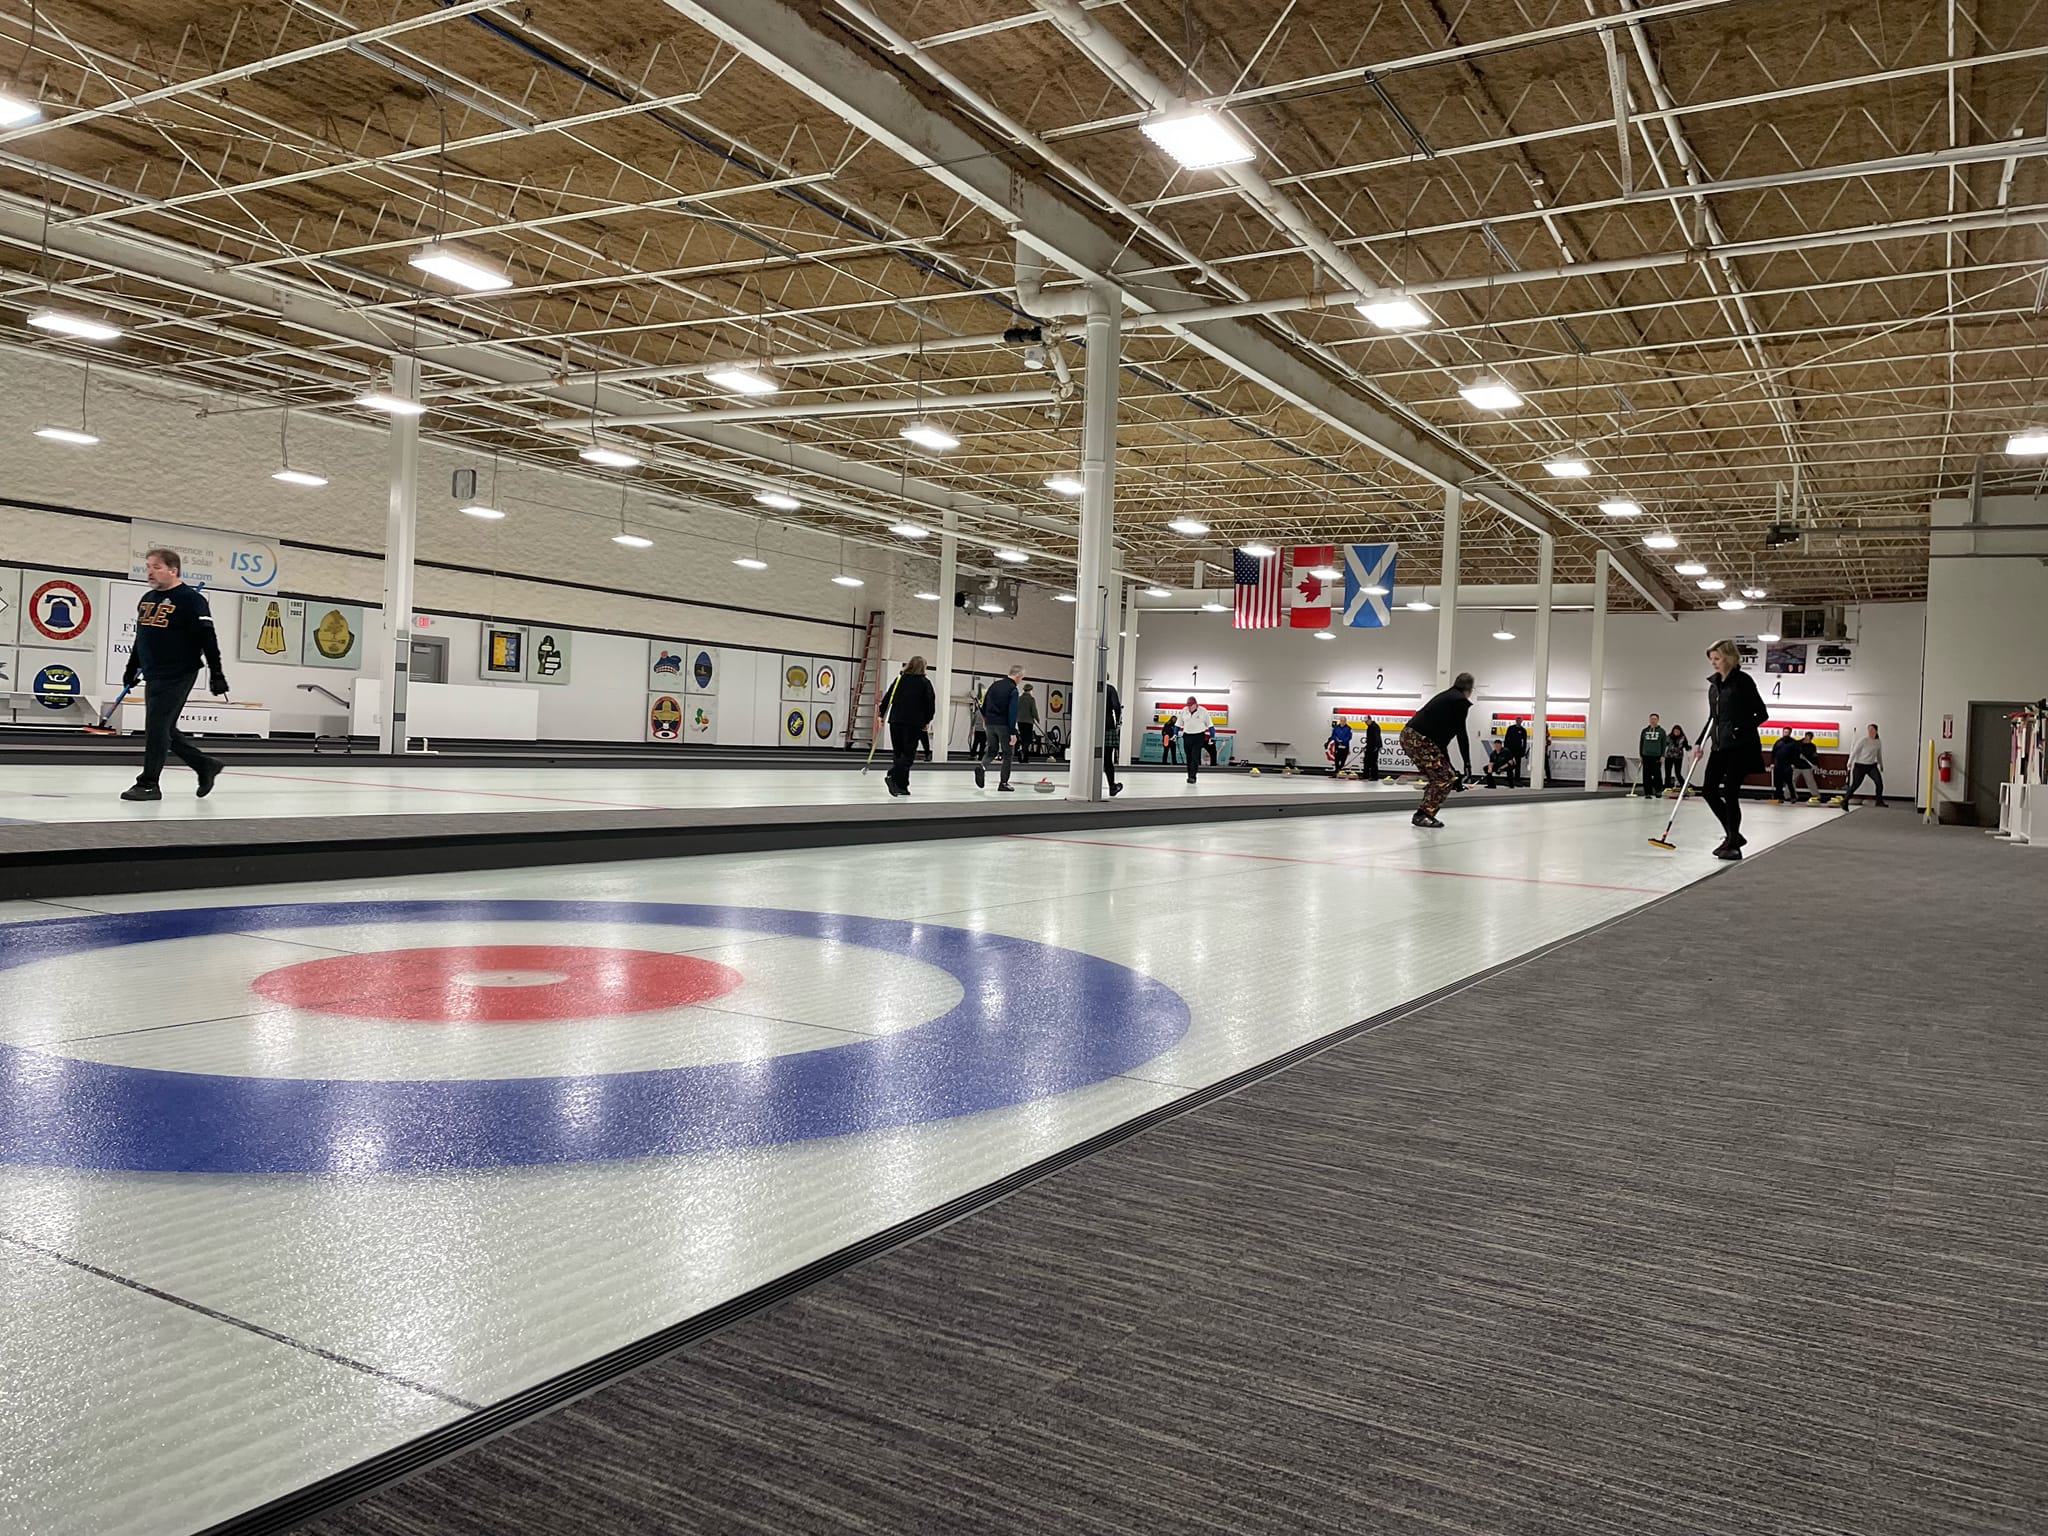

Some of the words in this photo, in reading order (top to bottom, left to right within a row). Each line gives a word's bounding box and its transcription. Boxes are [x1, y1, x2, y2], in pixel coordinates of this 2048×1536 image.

[230, 552, 263, 573] ISS
[1814, 656, 1853, 665] COIT
[1191, 671, 1198, 687] 1
[1376, 673, 1384, 690] 2
[1772, 681, 1782, 699] 4
